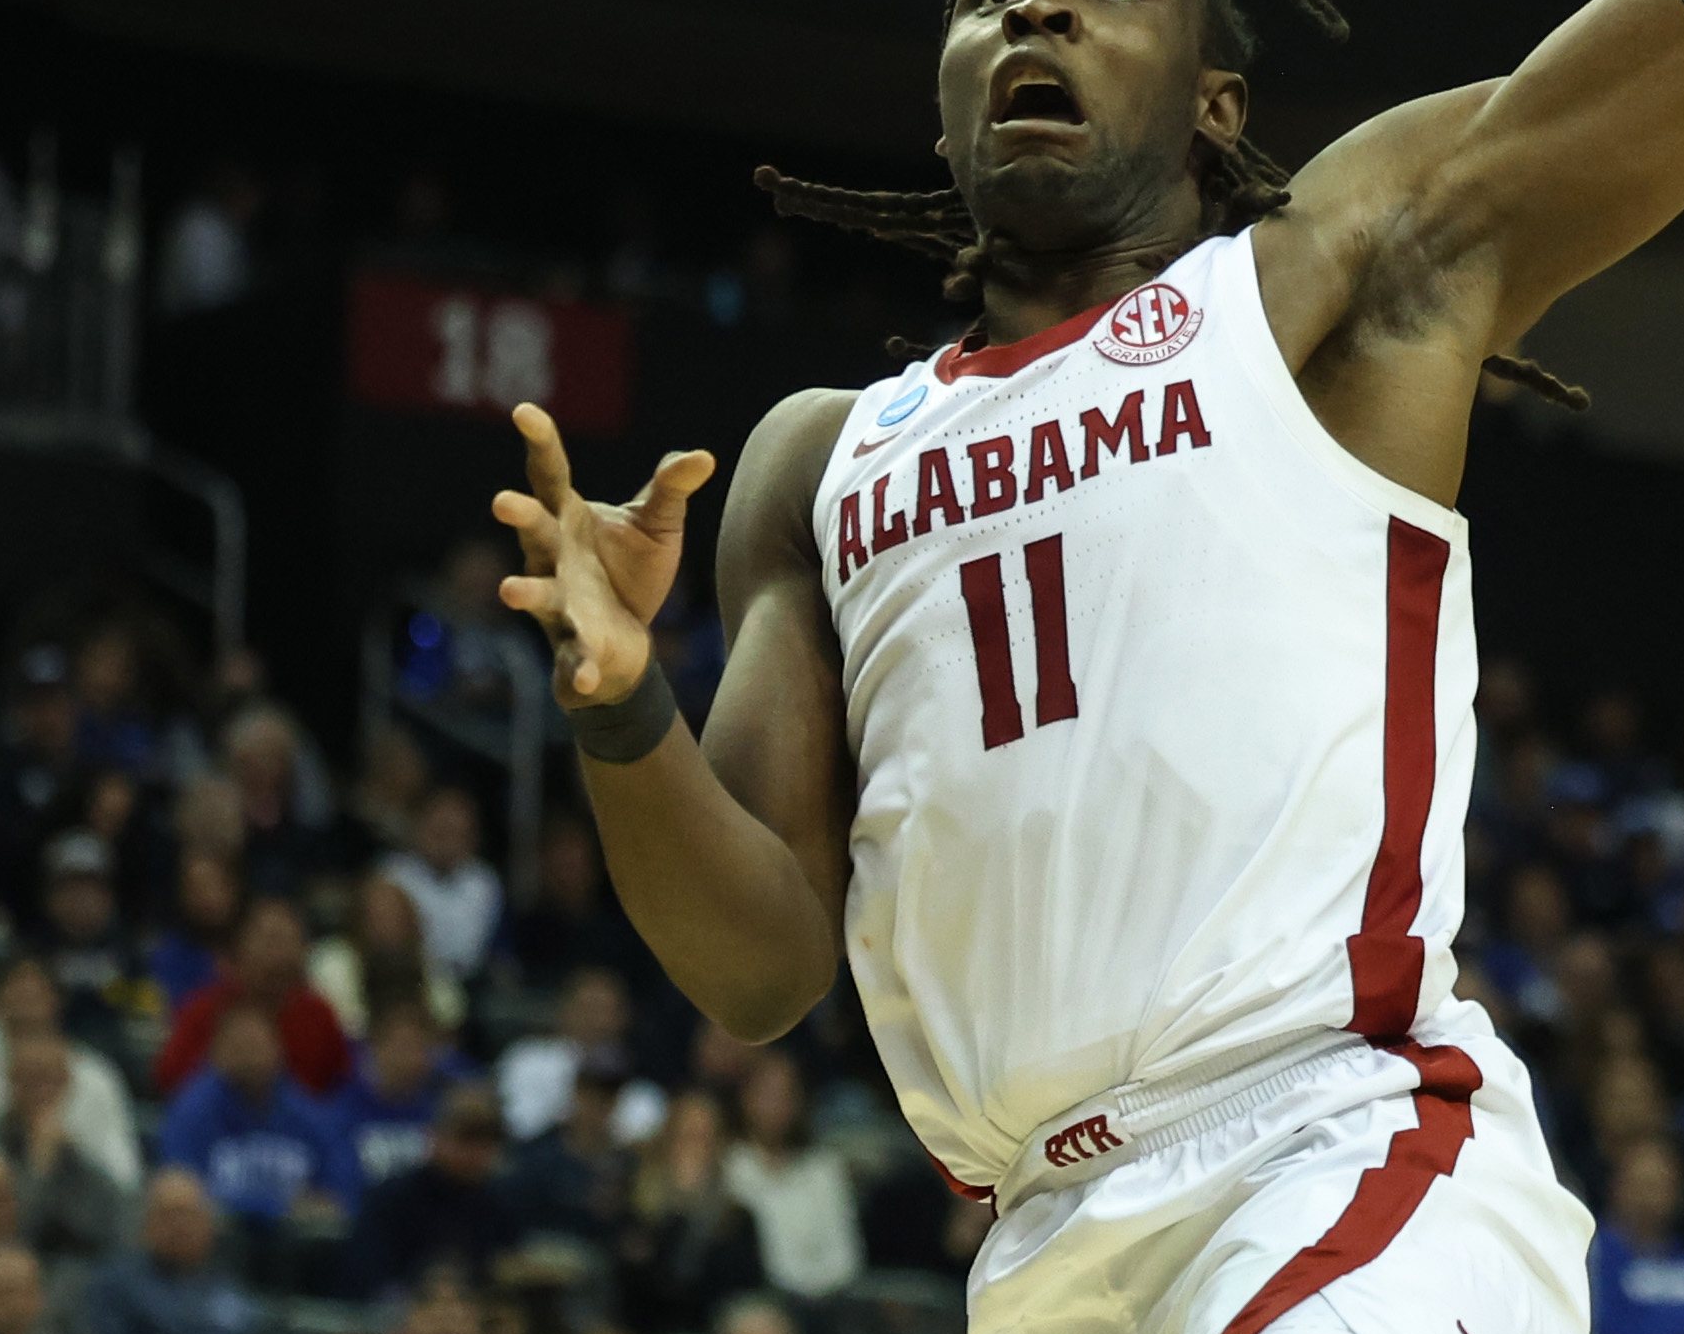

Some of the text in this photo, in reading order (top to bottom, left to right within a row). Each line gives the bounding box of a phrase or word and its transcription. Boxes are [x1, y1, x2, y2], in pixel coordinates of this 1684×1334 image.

[1109, 327, 1194, 364] GRADUATE
[1114, 286, 1186, 346] SEC
[838, 380, 1212, 586] ALABAMA
[960, 533, 1078, 750] 11
[1044, 1114, 1124, 1167] RTR
